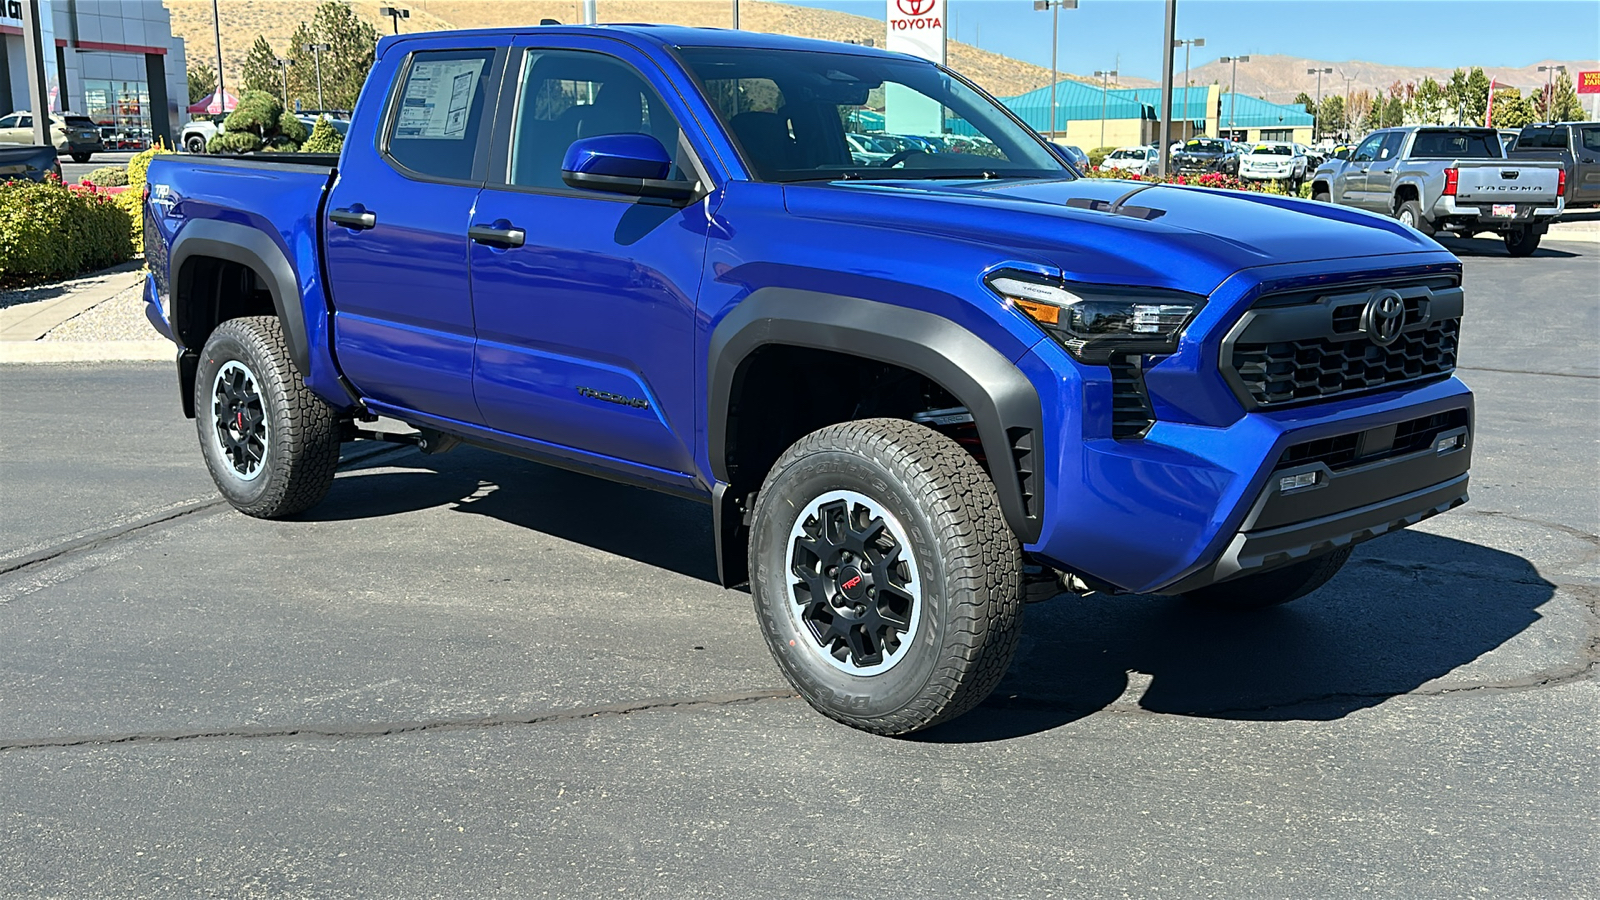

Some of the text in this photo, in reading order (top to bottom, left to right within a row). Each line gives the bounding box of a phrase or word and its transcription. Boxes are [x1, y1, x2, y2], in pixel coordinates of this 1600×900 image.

[890, 18, 942, 31] TOYOTA
[1023, 286, 1052, 295] TACOMA
[576, 386, 648, 409] TACOMA
[941, 415, 963, 423] TRD
[841, 575, 862, 590] TRD
